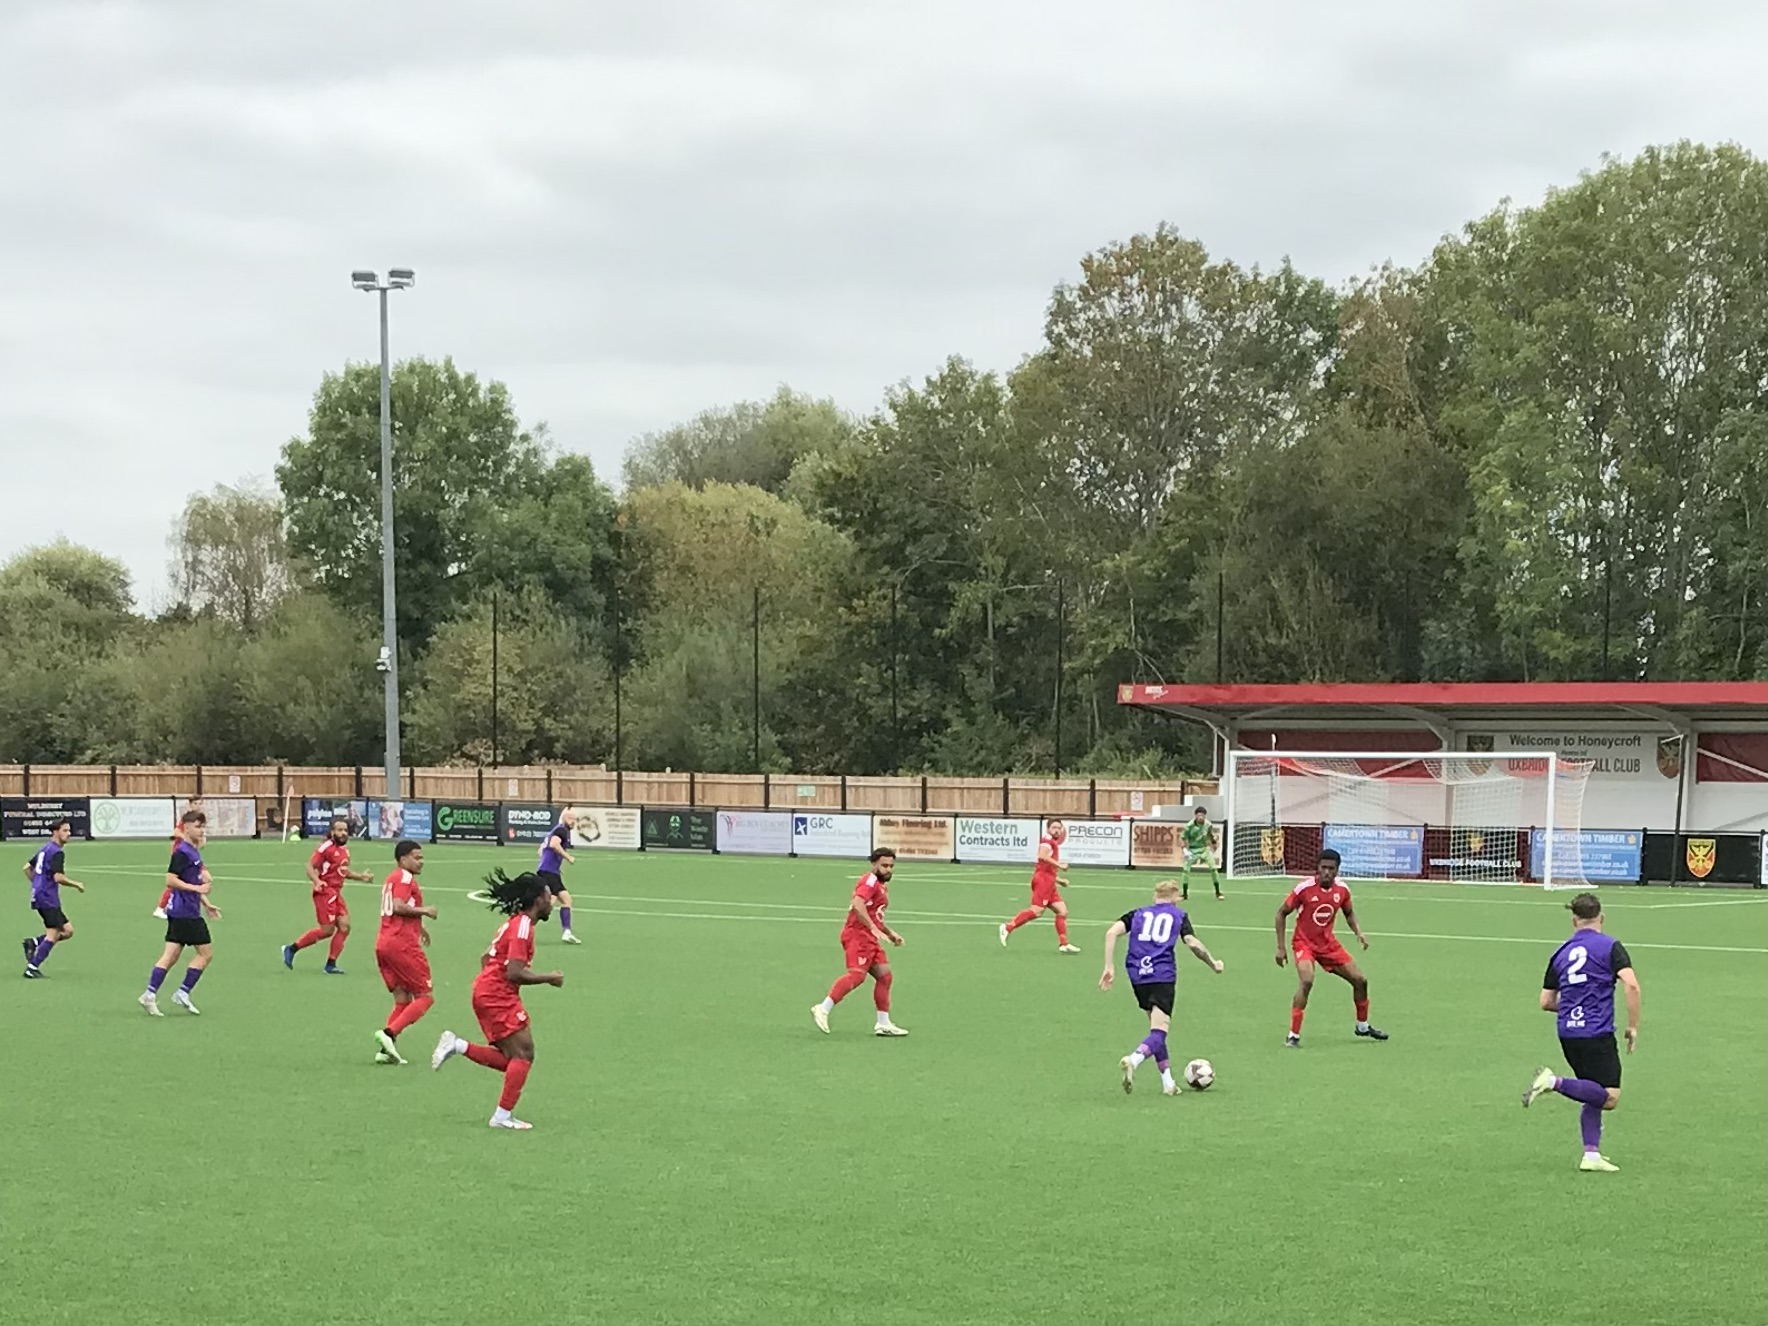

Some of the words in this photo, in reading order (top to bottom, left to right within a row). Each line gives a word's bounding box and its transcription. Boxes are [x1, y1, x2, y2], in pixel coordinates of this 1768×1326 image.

[1509, 735, 1560, 746] Welcome
[1563, 736, 1575, 746] to
[1578, 735, 1641, 750] Honeycroft
[1613, 758, 1641, 772] CLUB
[810, 817, 834, 829] GRC
[902, 819, 932, 830] Flooring
[960, 820, 1018, 835] Western
[1134, 825, 1174, 842] SHIPPS
[1379, 829, 1408, 839] TIMBER
[1593, 834, 1625, 844] TIMBER
[959, 835, 1010, 847] Contracts
[1013, 836, 1028, 847] ltd
[1138, 911, 1174, 944] 10
[1567, 945, 1588, 985] 2
